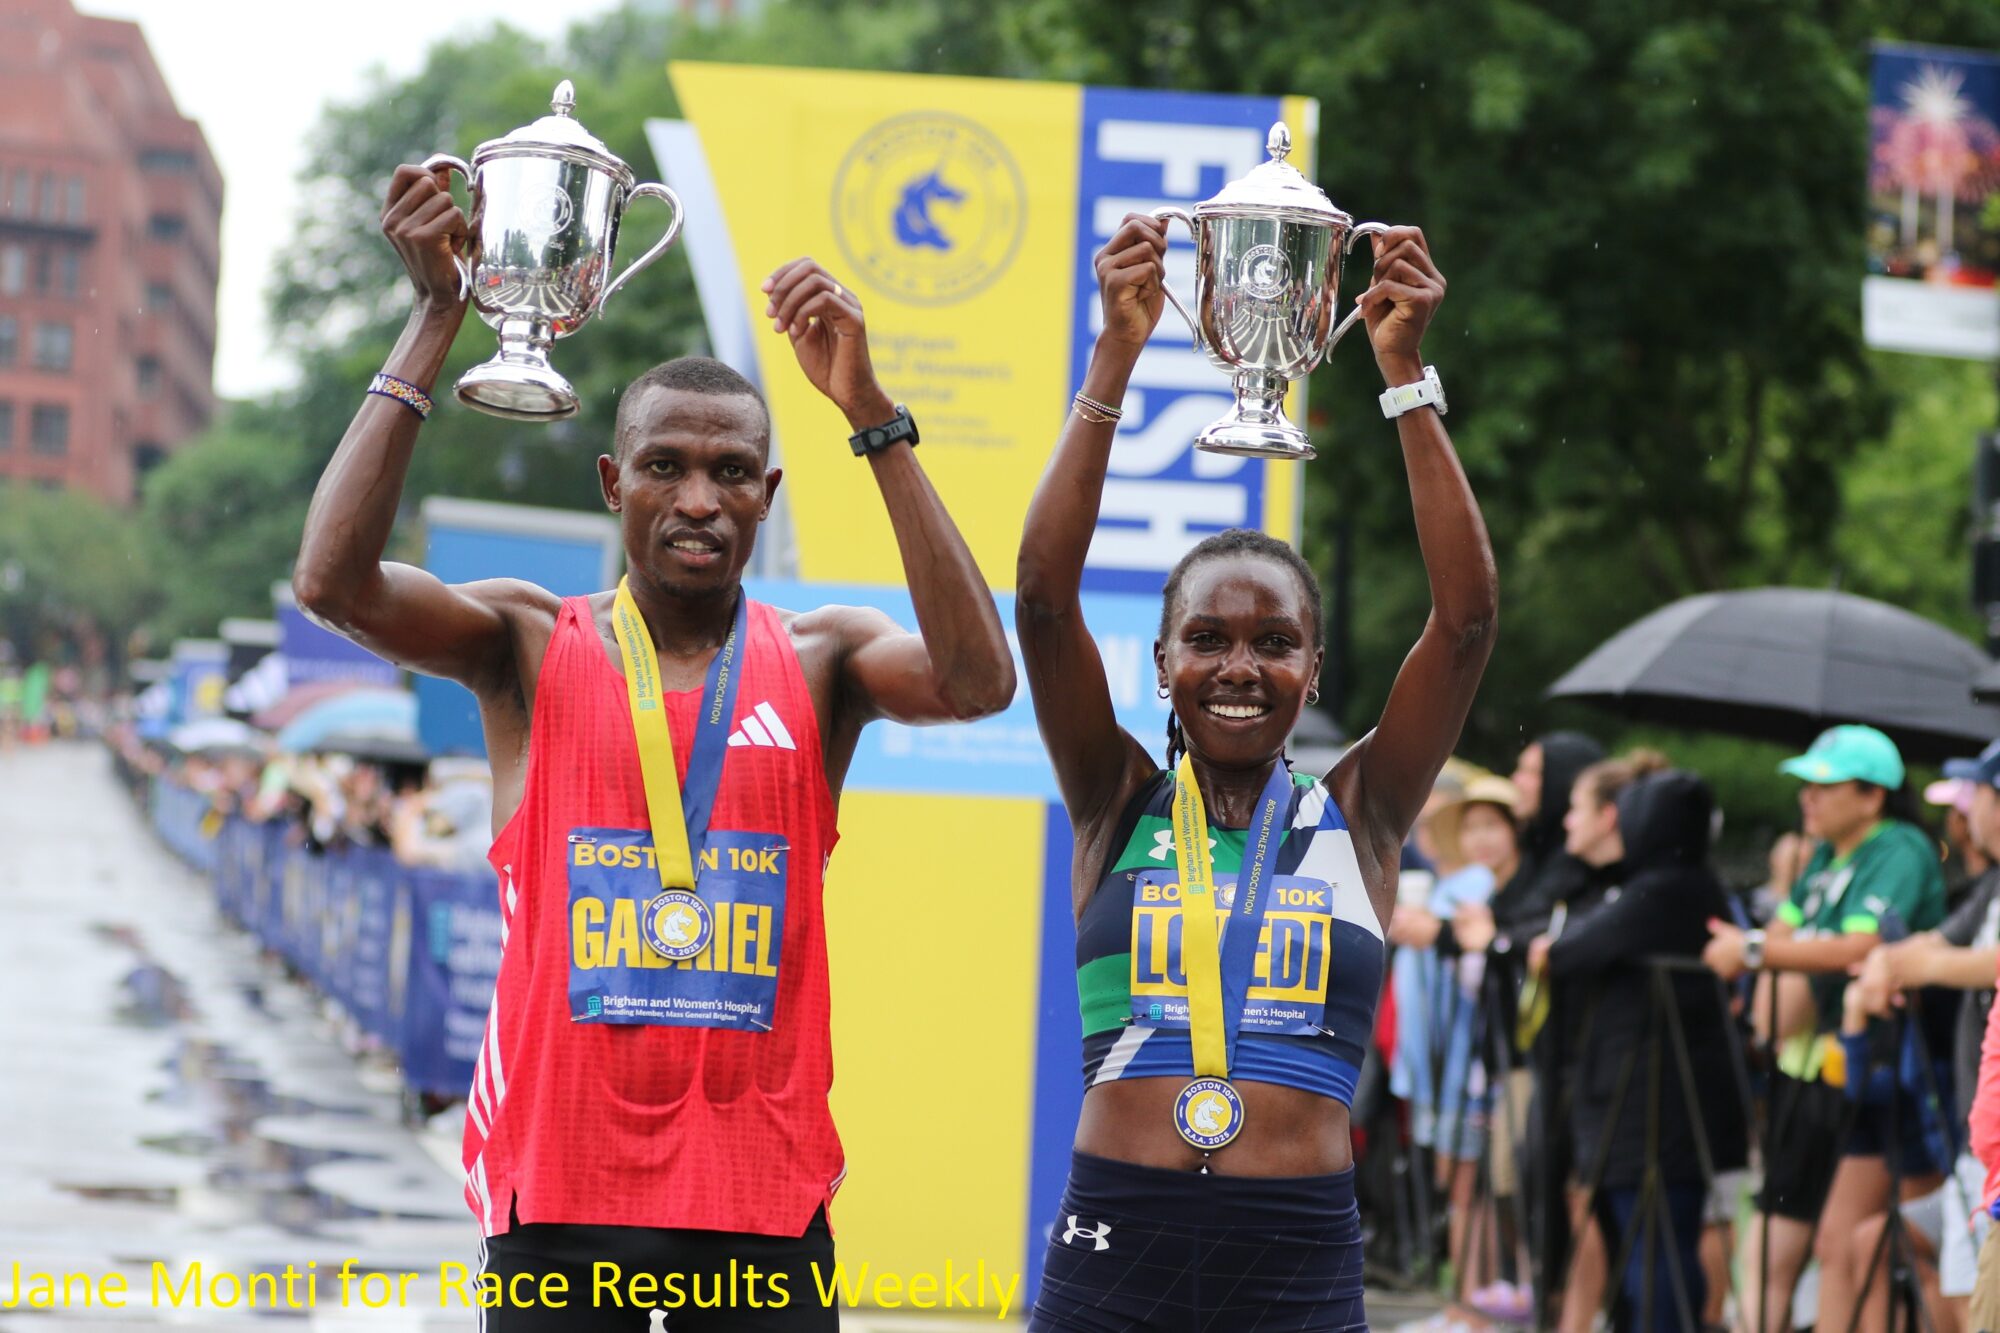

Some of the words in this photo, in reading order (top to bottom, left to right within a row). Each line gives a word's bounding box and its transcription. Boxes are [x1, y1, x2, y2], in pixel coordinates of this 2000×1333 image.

[710, 665, 729, 725] ASSOCIATION
[1181, 806, 1191, 836] Women's
[1263, 798, 1277, 825] BOSTON
[1183, 837, 1193, 851] and
[1255, 825, 1270, 861] ATHLETIC
[574, 844, 719, 870] BOSTN
[728, 848, 780, 874] 10K
[1186, 853, 1197, 882] Brigham
[1243, 861, 1262, 915] ASSOCIATION
[1277, 888, 1326, 906] 10K
[652, 894, 689, 911] BOSTON
[690, 899, 706, 914] 10K
[653, 939, 676, 956] B.A.A.
[678, 943, 700, 956] 2025
[603, 995, 648, 1009] Brigham
[650, 997, 670, 1008] and
[673, 998, 723, 1010] Women's
[724, 1002, 761, 1015] Hospital
[604, 1008, 635, 1017] Founding
[635, 1009, 665, 1018] Member,
[685, 1012, 712, 1020] General
[713, 1012, 737, 1021] Brigham
[1165, 1003, 1189, 1014] Brigh
[1270, 1008, 1306, 1020] Hospital
[1259, 1018, 1284, 1026] Brigham
[1184, 1082, 1222, 1098] BOSTON
[1222, 1086, 1238, 1102] 10K
[1184, 1127, 1206, 1145] B.A.A.
[1209, 1131, 1230, 1145] 2025
